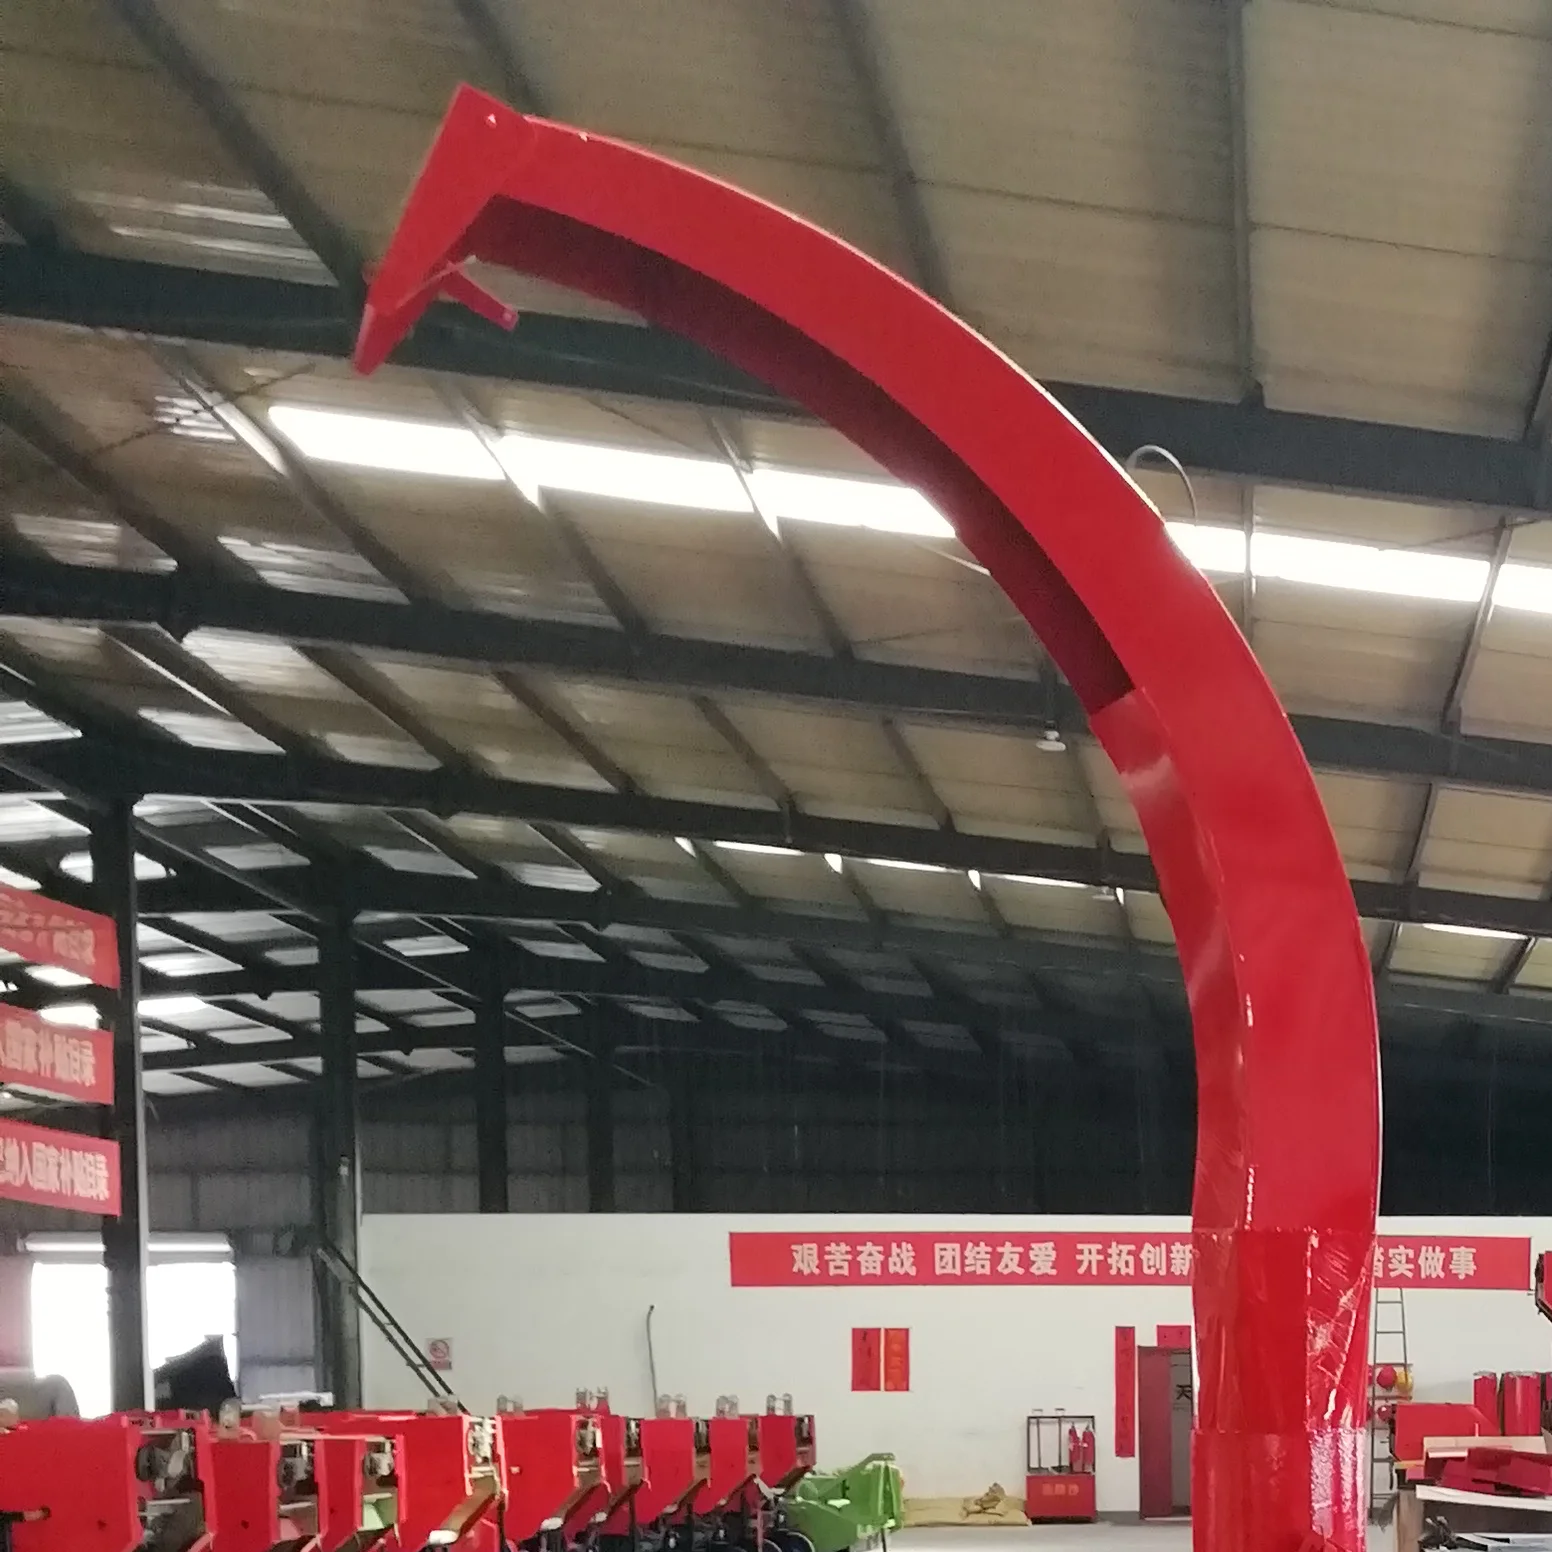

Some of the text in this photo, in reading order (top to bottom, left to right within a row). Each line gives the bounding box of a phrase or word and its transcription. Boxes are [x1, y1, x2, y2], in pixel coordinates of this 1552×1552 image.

[791, 1242, 917, 1276] 艰苦奋战
[933, 1242, 1058, 1276] 团结友爱
[1075, 1242, 1193, 1276] 开拓创新
